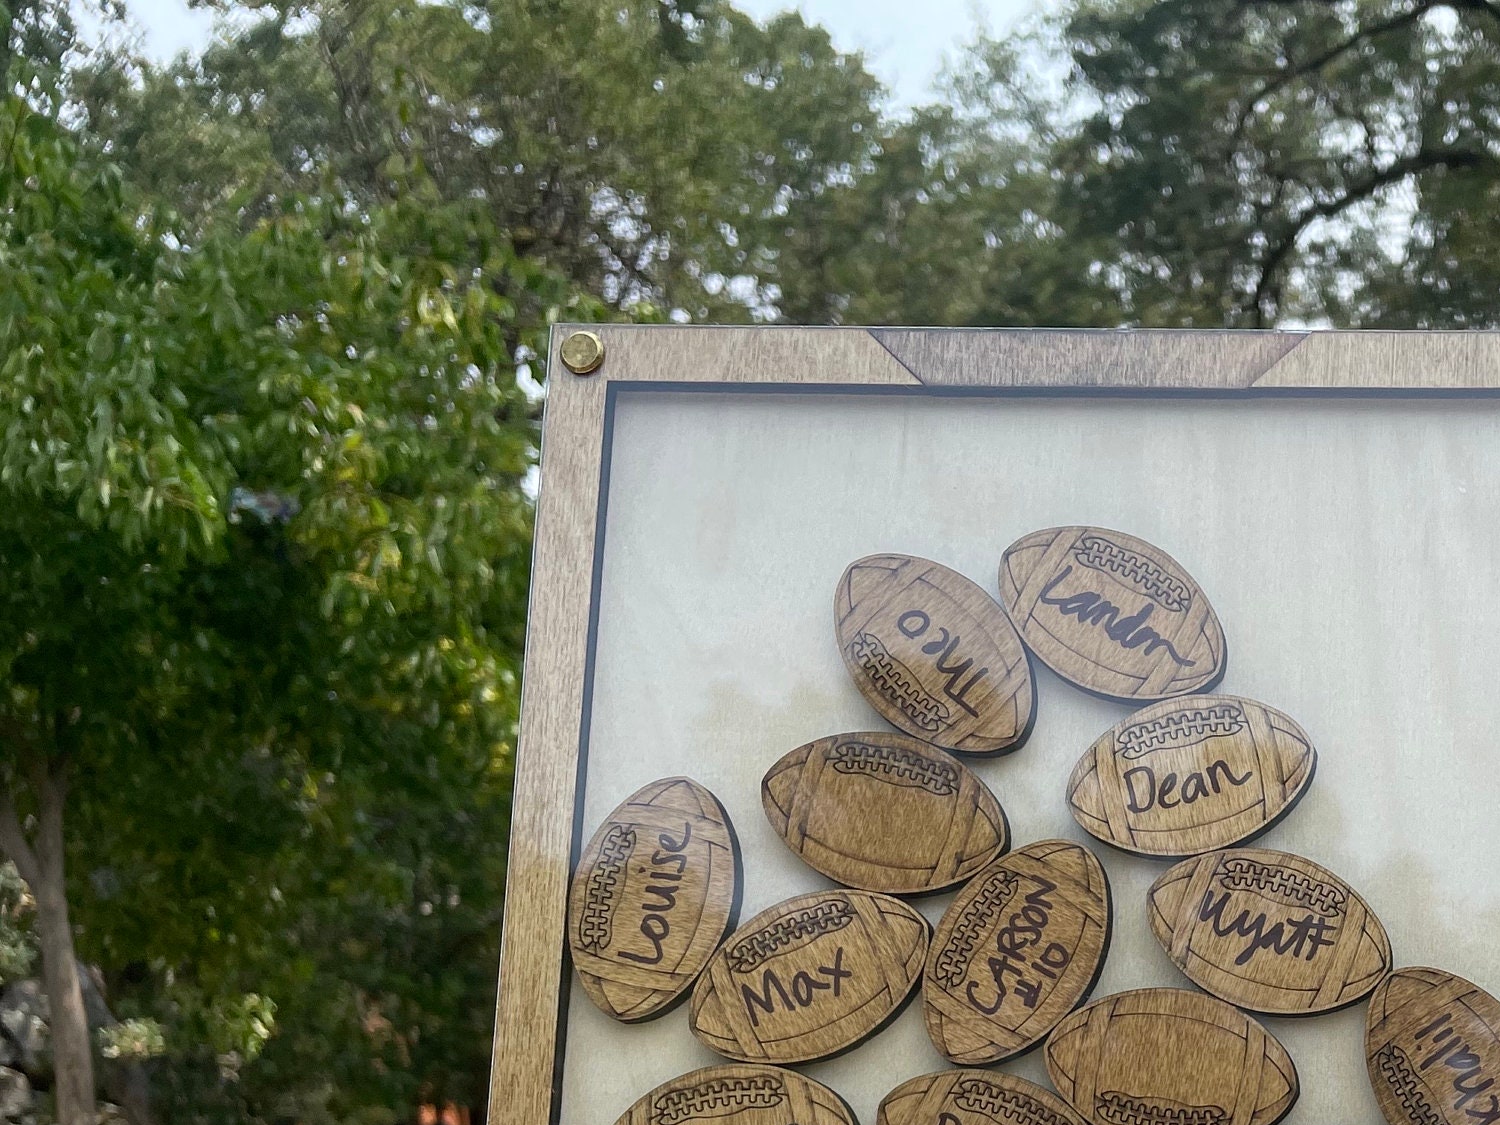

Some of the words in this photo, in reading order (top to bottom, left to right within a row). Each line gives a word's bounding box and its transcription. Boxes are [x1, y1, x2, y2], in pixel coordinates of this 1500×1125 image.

[897, 609, 987, 719] Theo
[1123, 758, 1252, 814] Dean
[618, 822, 691, 965] Louise
[1200, 889, 1338, 966] Wyatt
[741, 946, 852, 1027] Max
[966, 874, 1058, 1016] CARSON
